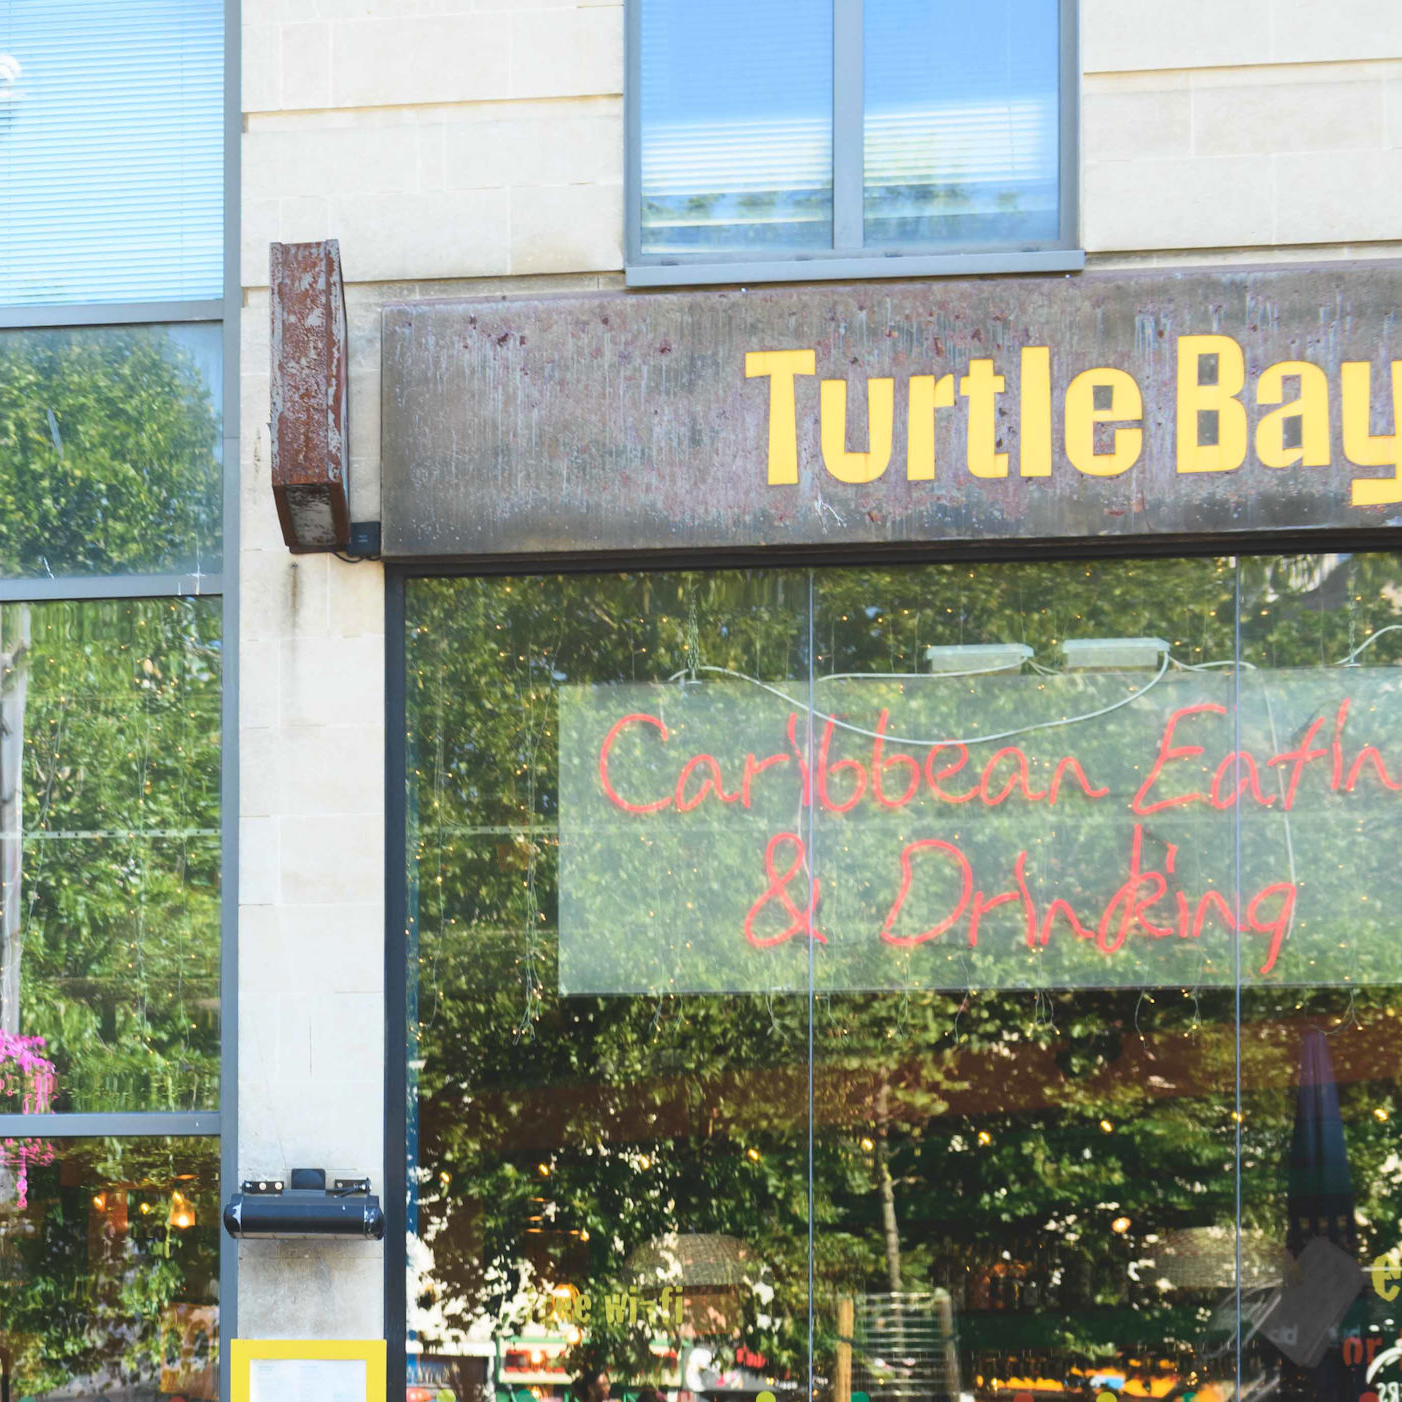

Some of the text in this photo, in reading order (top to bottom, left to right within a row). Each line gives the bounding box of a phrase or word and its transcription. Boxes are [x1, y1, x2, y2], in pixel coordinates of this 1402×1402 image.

[744, 334, 1402, 506] Turtle Bay
[599, 697, 1402, 816] Caribbean Eatin
[742, 824, 1297, 974] & Drinking
[604, 1285, 684, 1326] wi-fi
